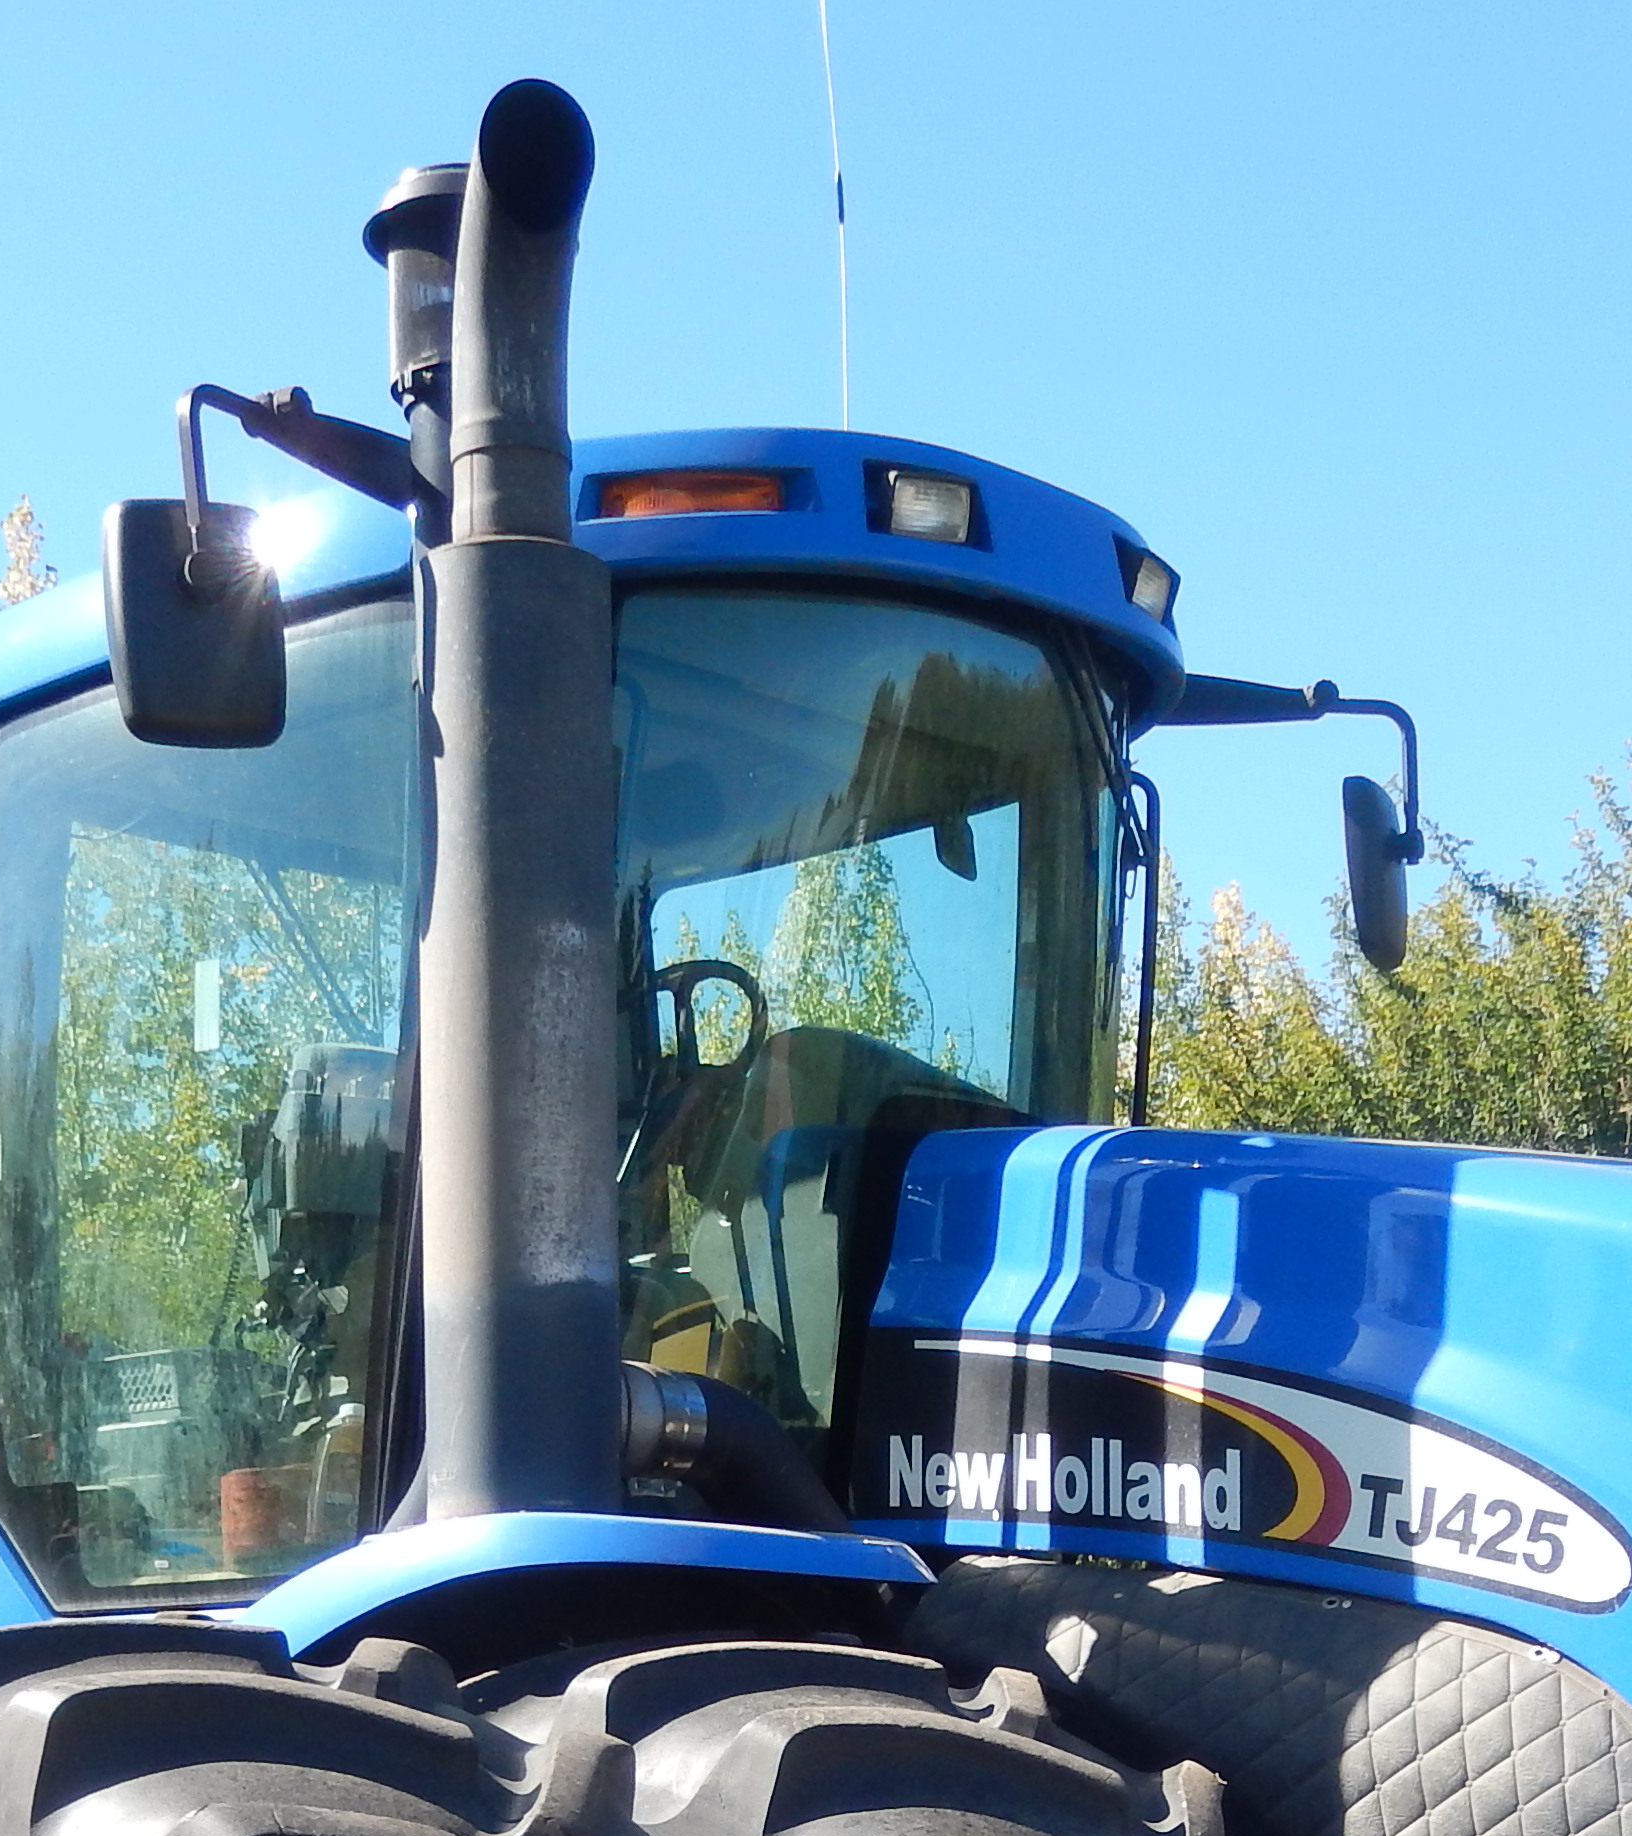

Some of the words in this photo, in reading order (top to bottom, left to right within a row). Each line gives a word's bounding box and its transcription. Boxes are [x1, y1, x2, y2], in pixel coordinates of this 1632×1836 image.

[888, 1434, 1005, 1510] New
[1015, 1433, 1242, 1532] Holland
[1359, 1475, 1570, 1574] TJ425
